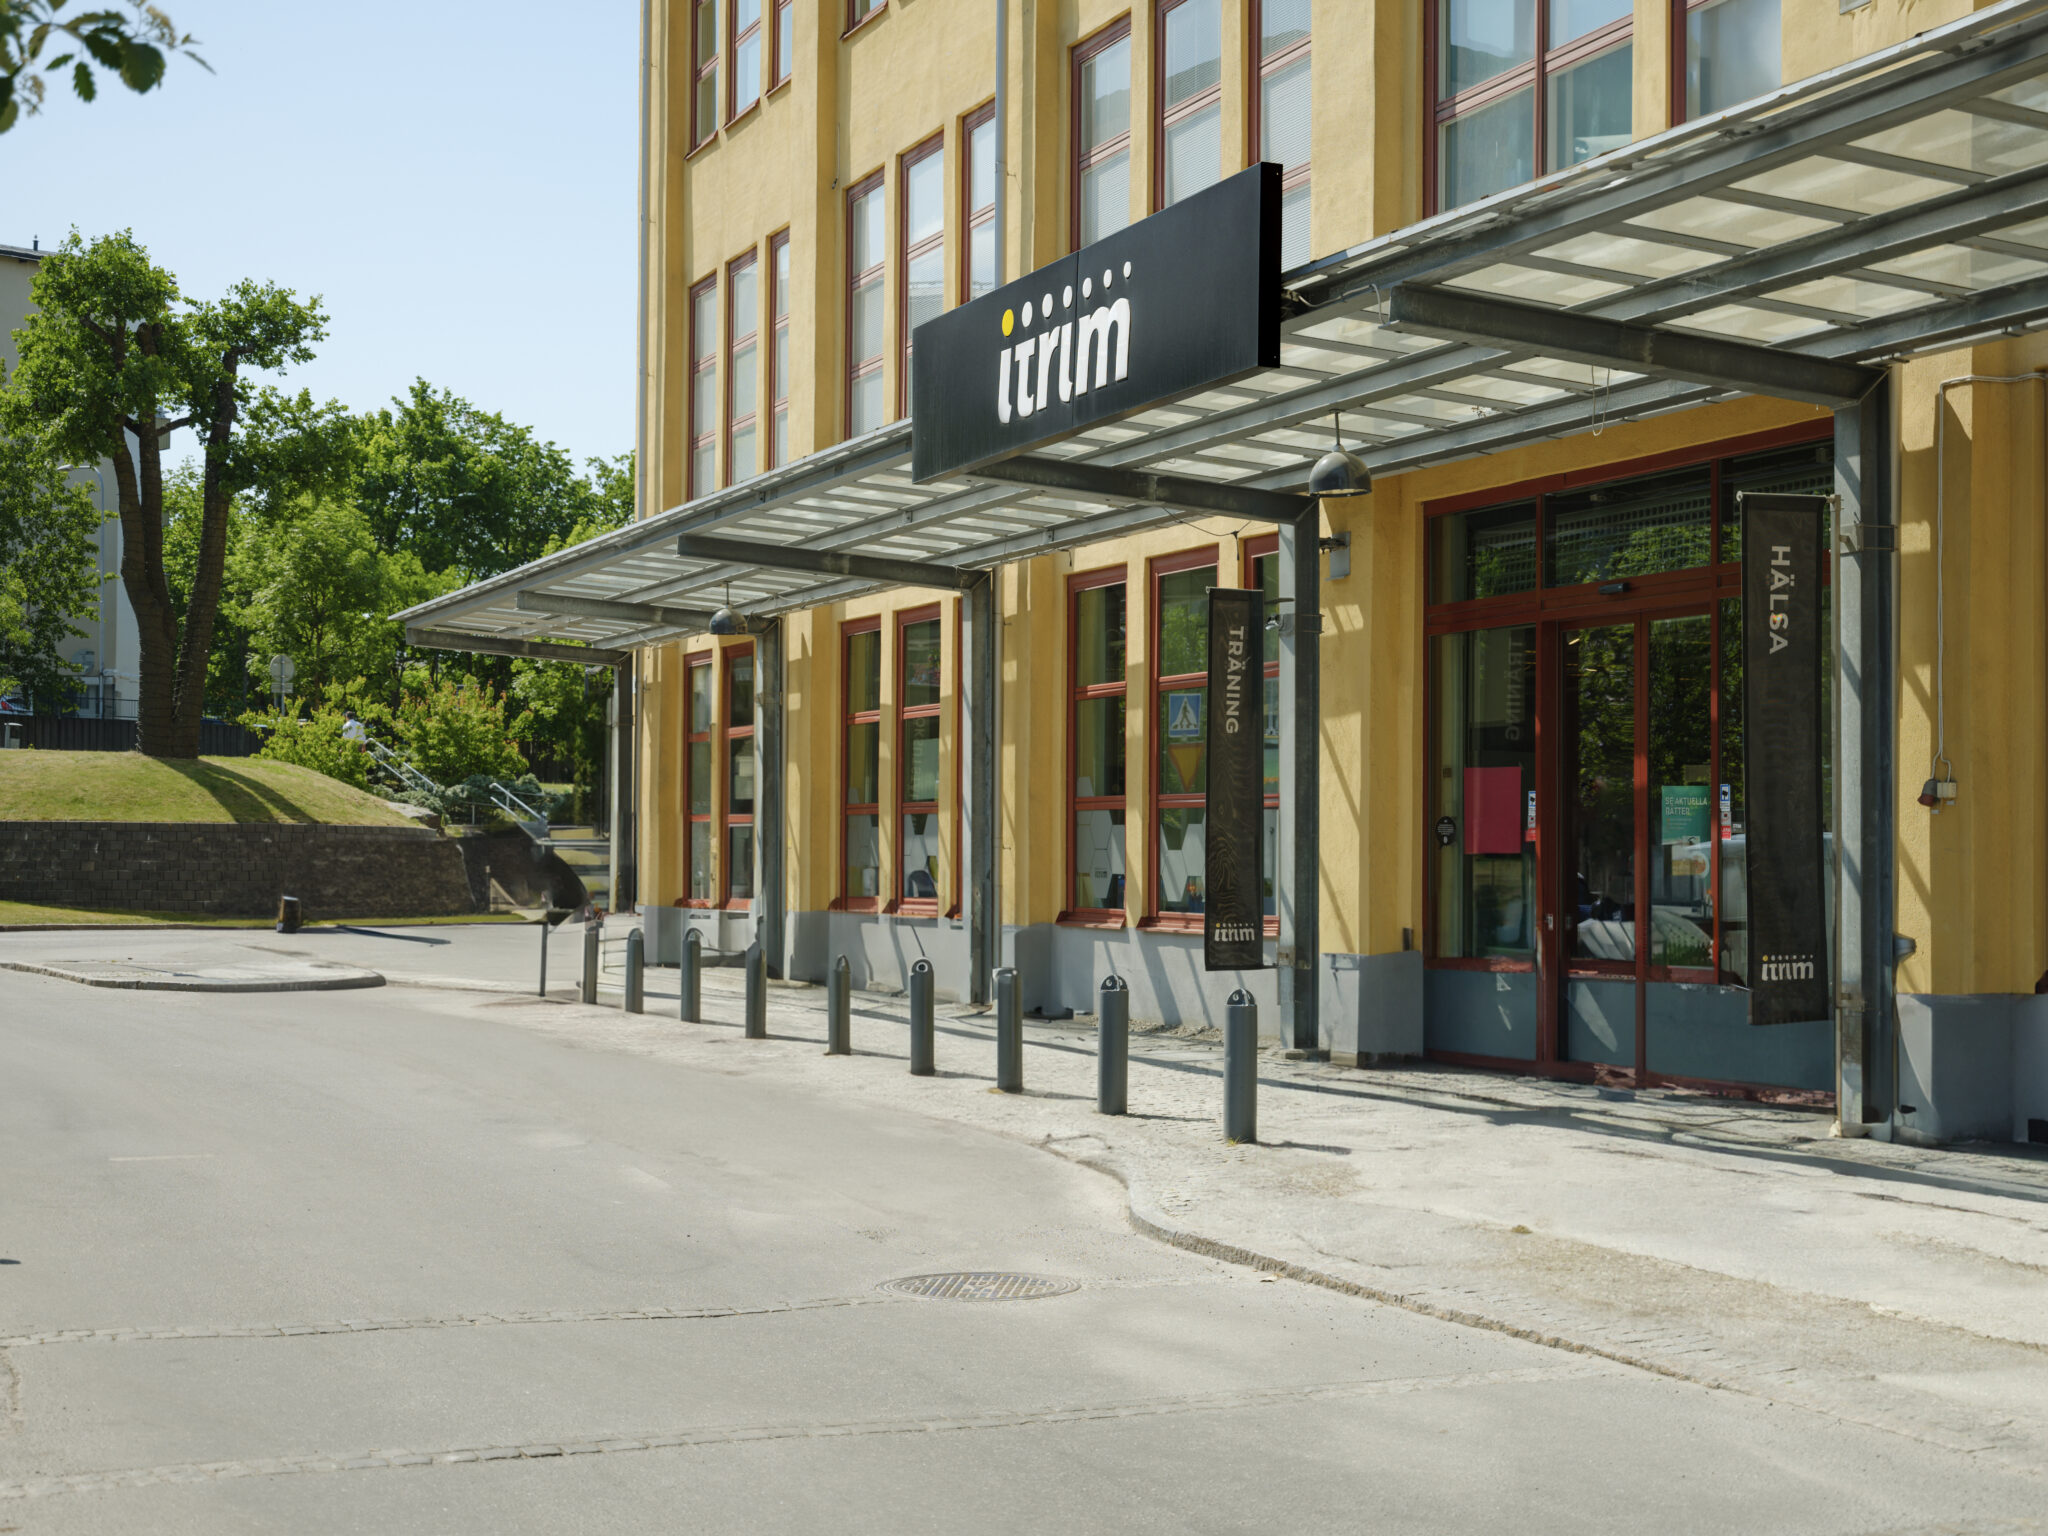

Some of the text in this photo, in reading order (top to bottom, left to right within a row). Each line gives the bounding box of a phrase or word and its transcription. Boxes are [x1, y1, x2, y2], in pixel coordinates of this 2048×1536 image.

[997, 261, 1131, 424] itrim
[1769, 545, 1795, 654] HÄLSA
[1225, 626, 1246, 734] TRÄNING
[1214, 922, 1255, 942] itrim
[1761, 954, 1814, 982] itrim
